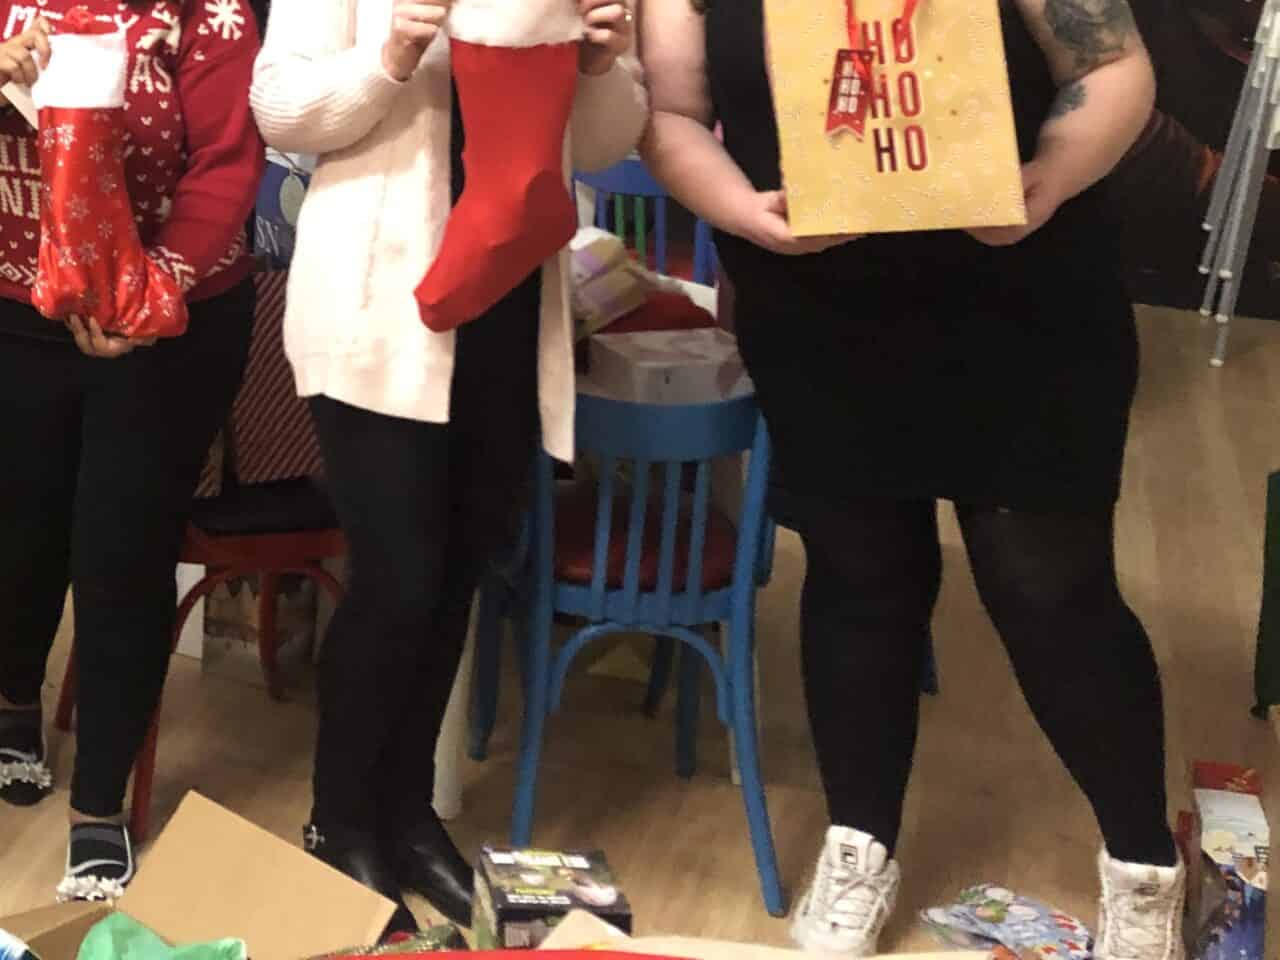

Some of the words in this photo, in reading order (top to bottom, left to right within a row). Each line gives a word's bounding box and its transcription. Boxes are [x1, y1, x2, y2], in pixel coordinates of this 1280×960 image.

[861, 19, 915, 64] HO
[870, 72, 921, 118] HO
[873, 125, 927, 172] HO
